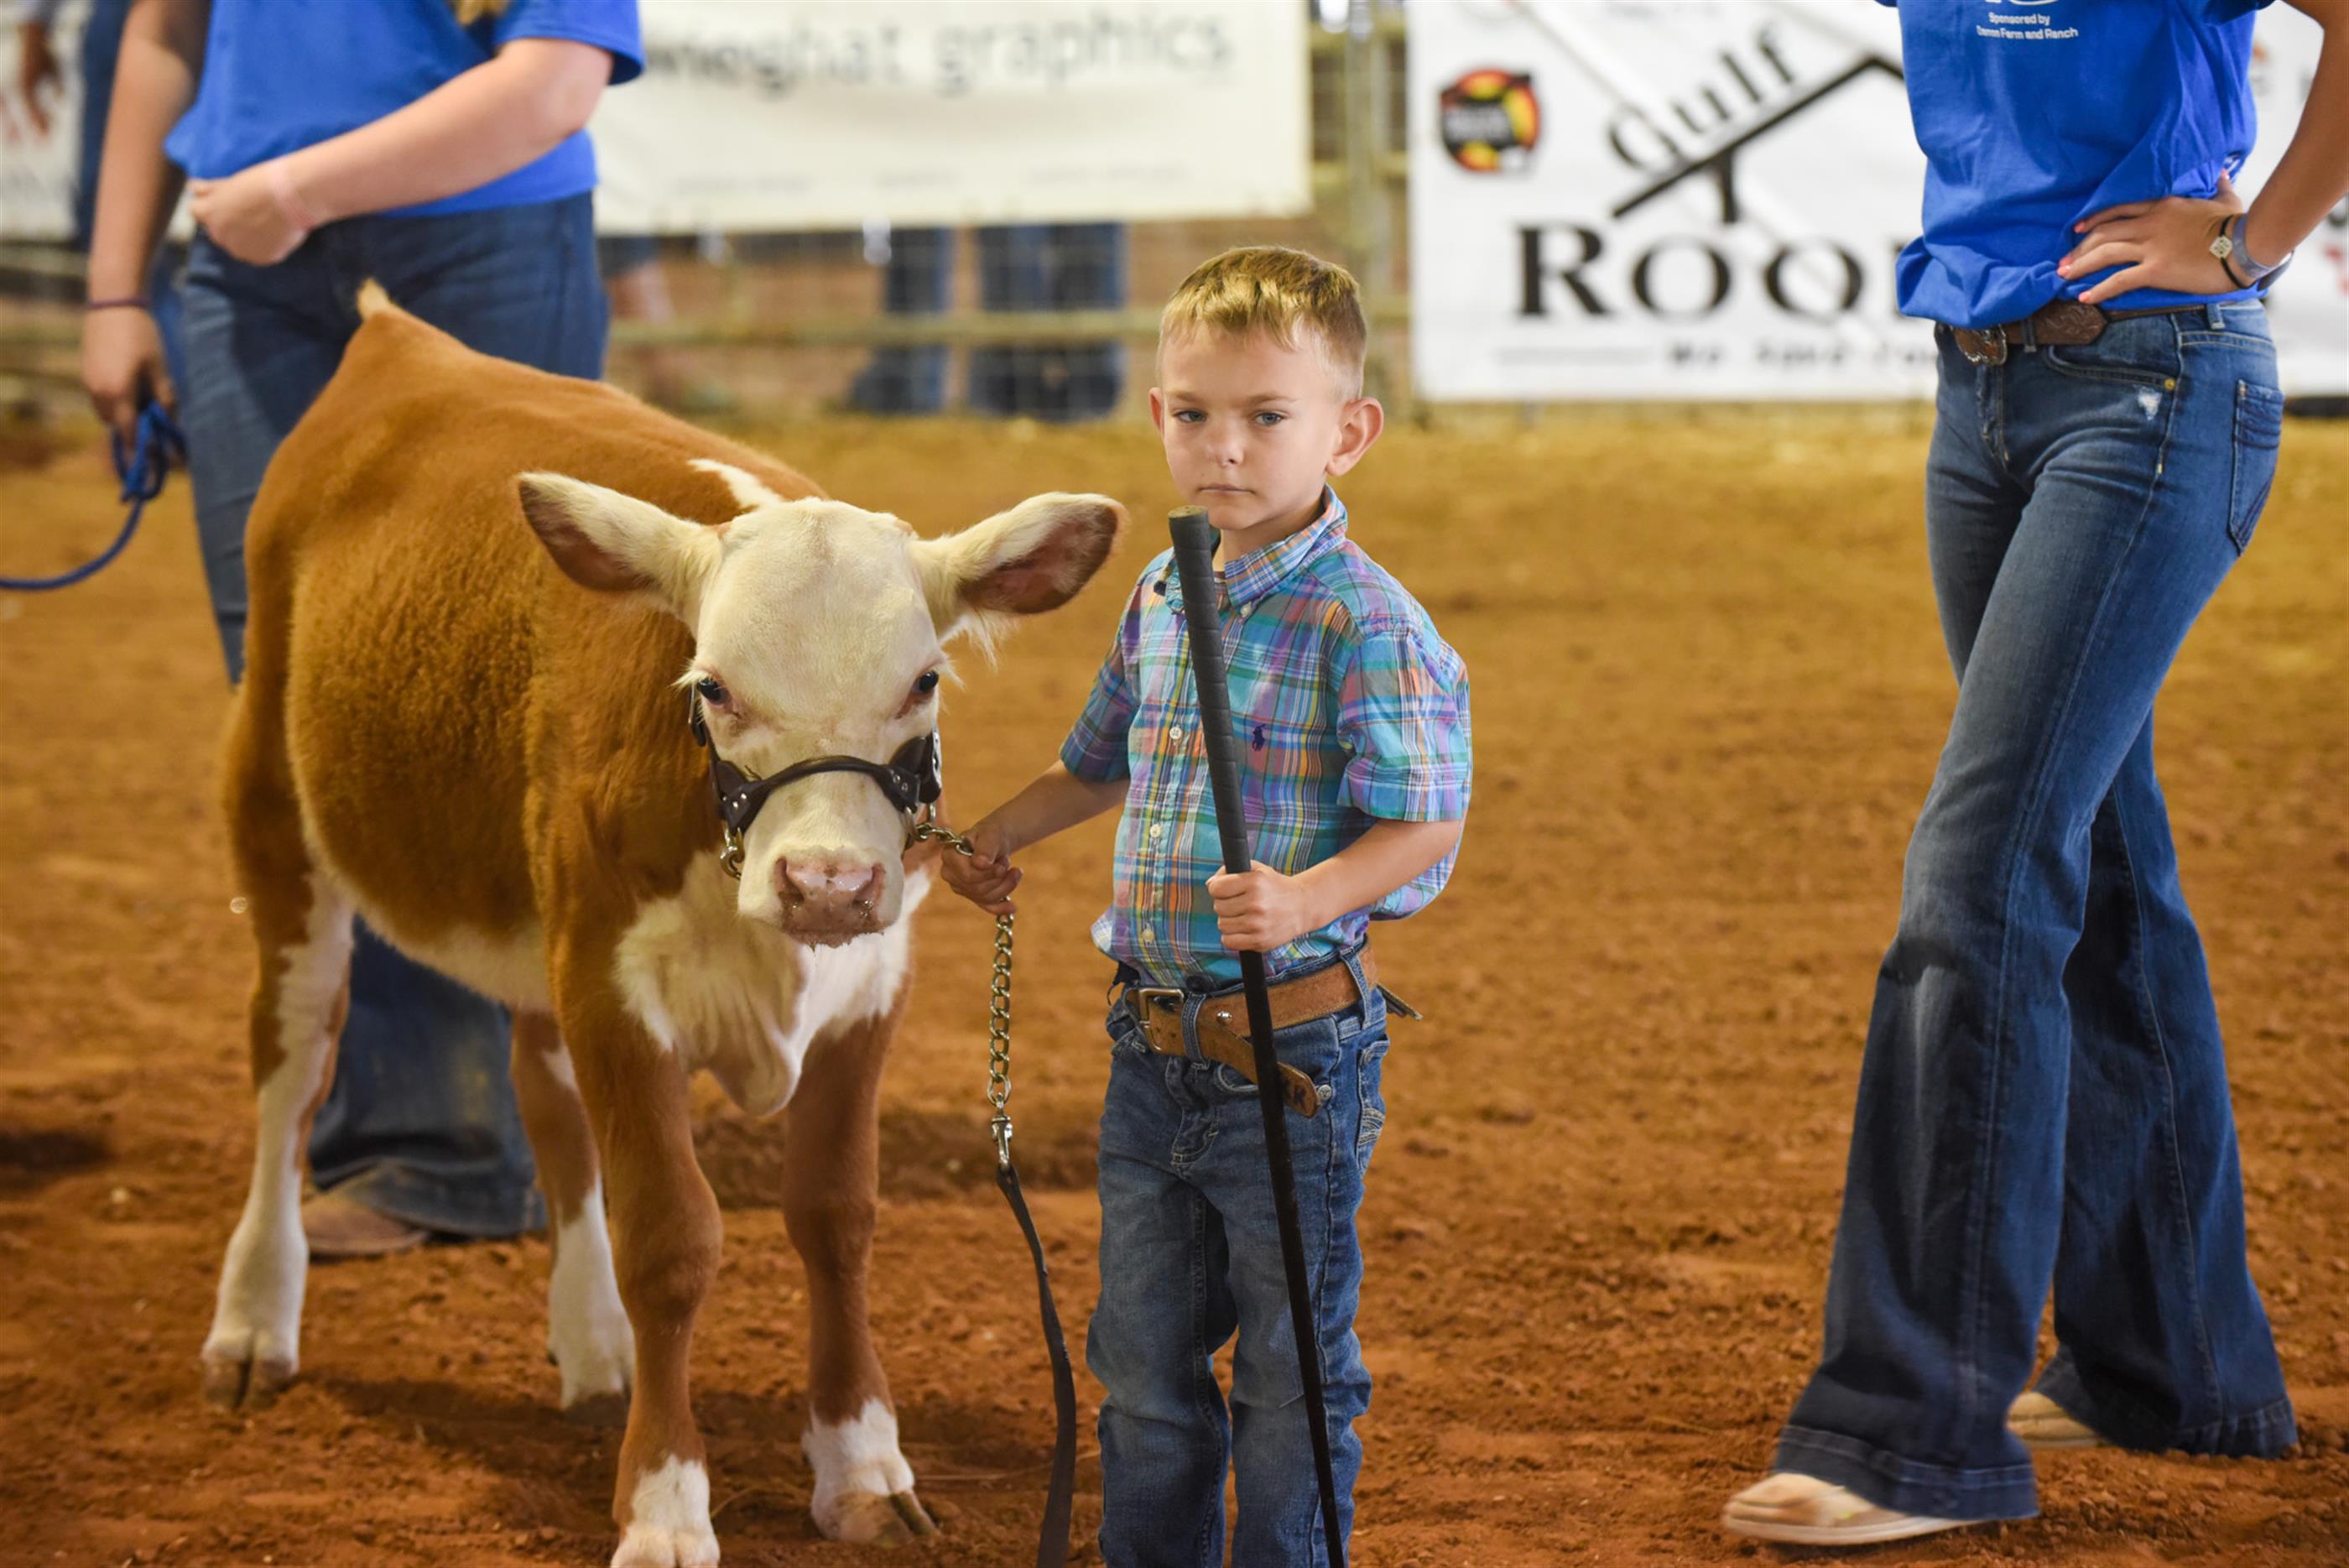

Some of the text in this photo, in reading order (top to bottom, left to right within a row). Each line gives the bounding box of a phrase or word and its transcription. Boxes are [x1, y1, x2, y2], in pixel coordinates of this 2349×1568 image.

[936, 10, 1237, 97] graphics
[1988, 12, 2051, 26] Sponsored by
[2000, 28, 2024, 39] Farm
[2025, 28, 2044, 39] and
[2044, 27, 2079, 39] Ranch
[1607, 22, 1795, 173] Gulf
[1515, 223, 1903, 322] ROO
